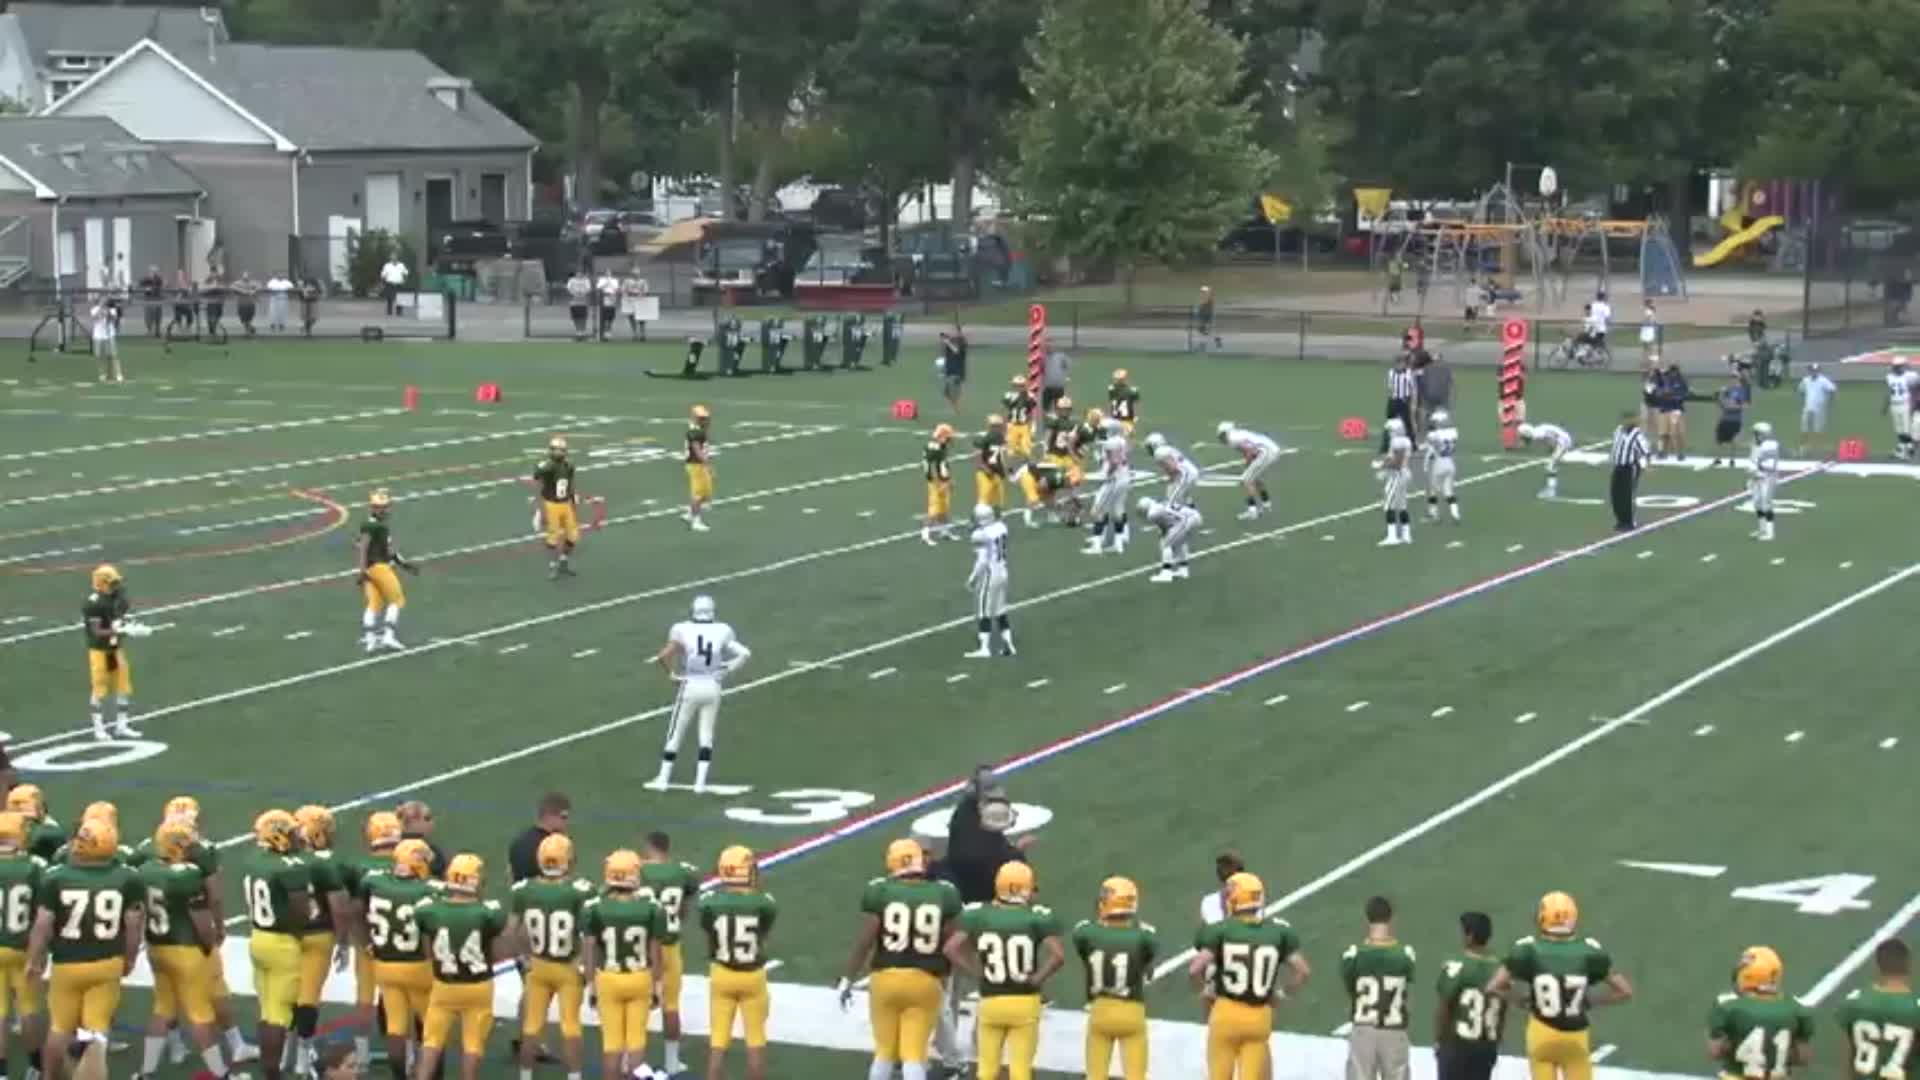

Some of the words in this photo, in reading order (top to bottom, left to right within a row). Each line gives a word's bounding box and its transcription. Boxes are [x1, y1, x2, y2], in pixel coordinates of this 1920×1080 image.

[697, 633, 713, 667] 4
[724, 788, 876, 824] 3
[0, 884, 33, 934] 6
[60, 889, 123, 940] 79
[1729, 872, 1877, 915] 4
[368, 896, 420, 951] 53
[602, 926, 649, 971] 13
[713, 915, 760, 963] 15
[883, 902, 943, 954] 99
[432, 927, 488, 975] 44
[977, 932, 1033, 984] 30
[1089, 949, 1130, 997] 11
[1222, 944, 1279, 997] 50
[1353, 976, 1407, 1026] 27
[1533, 973, 1588, 1017] 87
[1735, 1026, 1793, 1076] 41
[1853, 1020, 1916, 1079] 67
